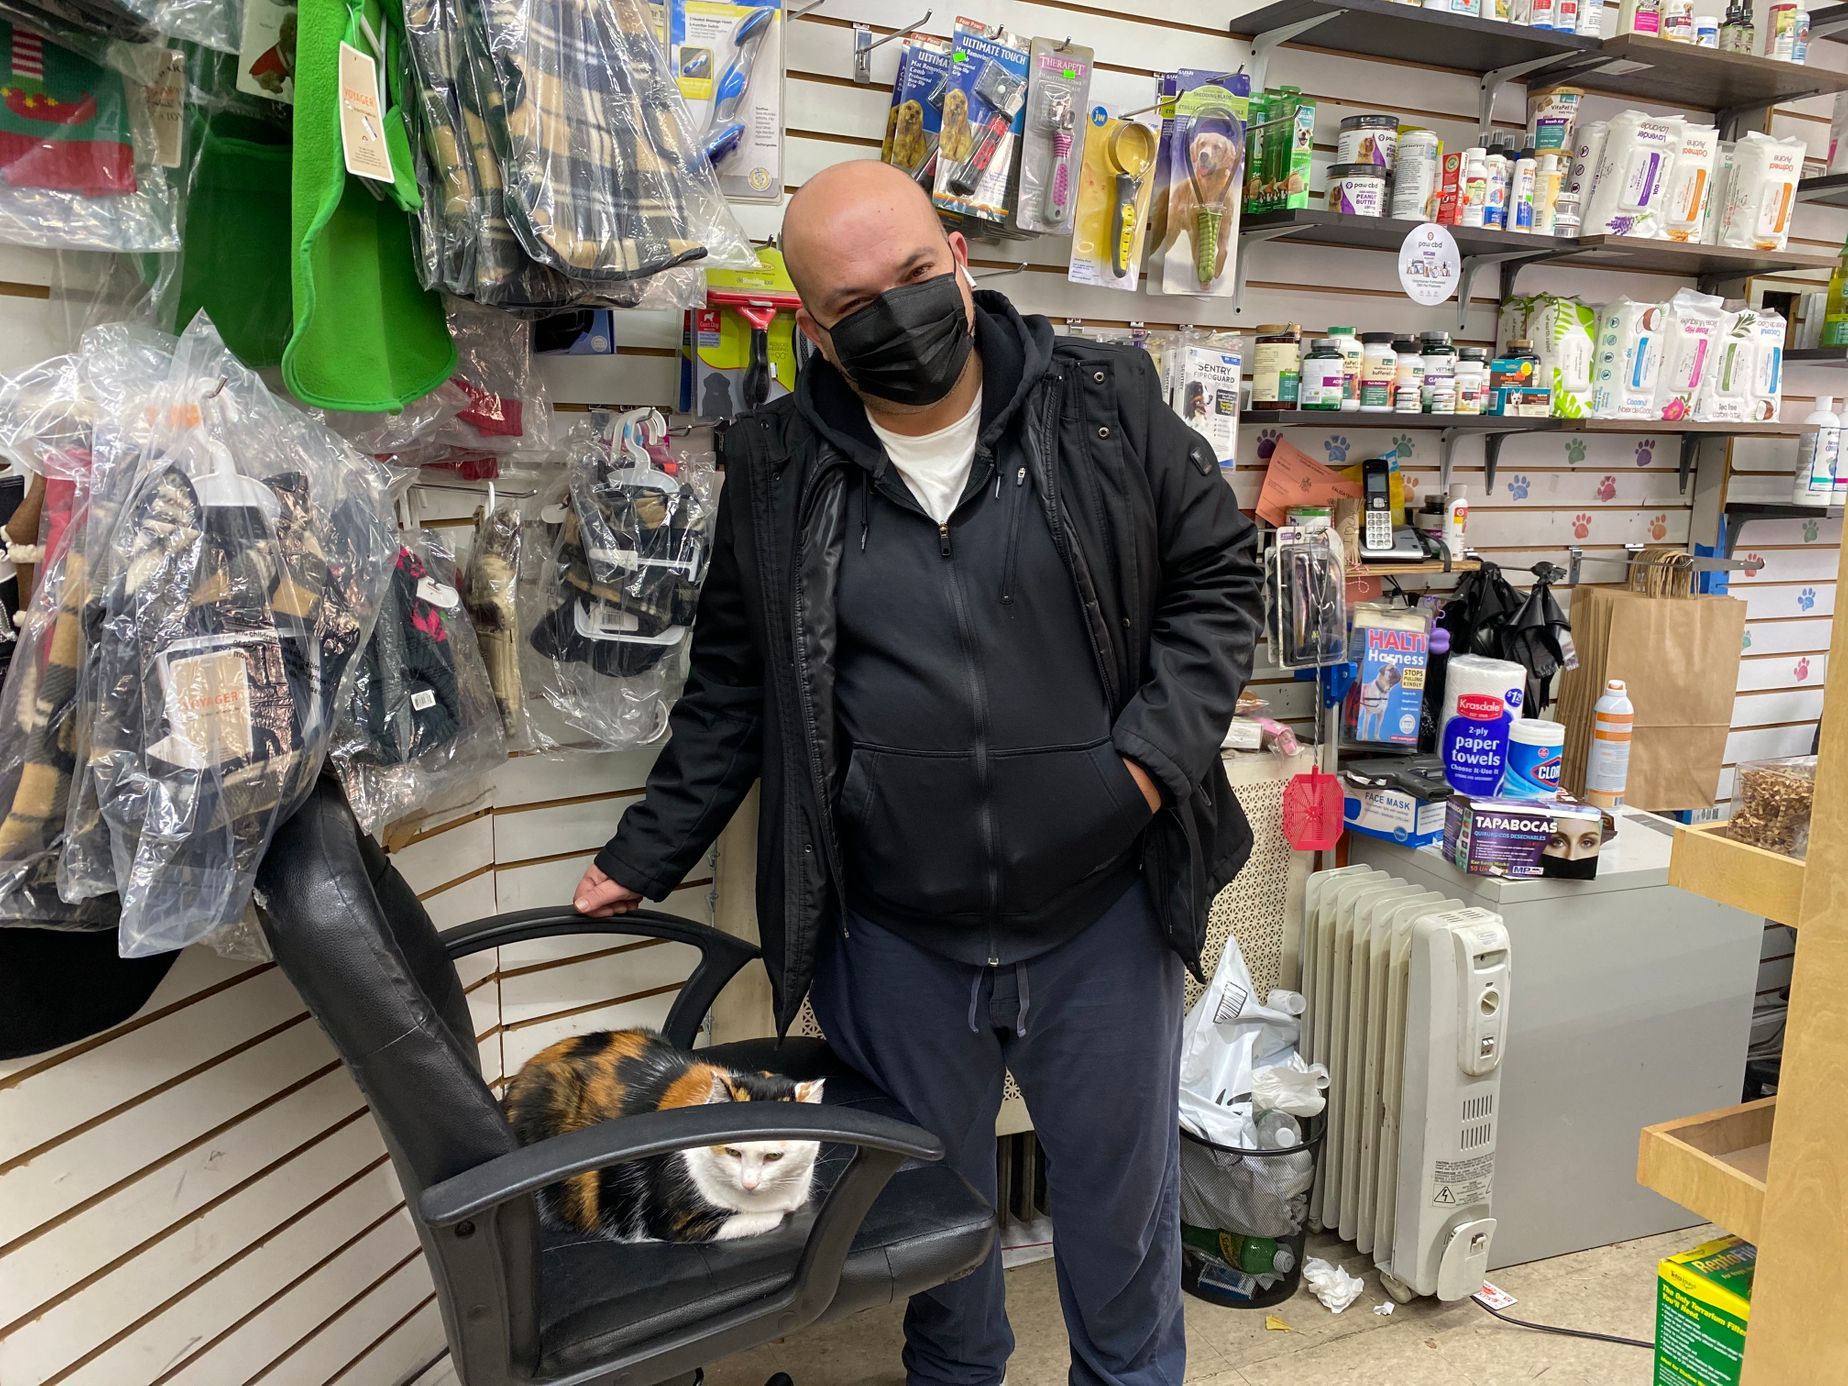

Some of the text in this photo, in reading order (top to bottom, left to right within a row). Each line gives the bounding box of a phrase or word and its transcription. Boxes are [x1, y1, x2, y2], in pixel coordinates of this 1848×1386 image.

[963, 37, 1026, 65] ULTIMATE TOUCH
[1641, 122, 1669, 133] Lavande
[1637, 131, 1666, 143] Lavender
[1760, 328, 1781, 336] Coconut
[1198, 364, 1232, 376] SENTRY
[1194, 371, 1235, 383] FIPROGUARD
[1627, 398, 1647, 406] Coconut
[1719, 403, 1738, 411] Tea Tree
[1368, 629, 1428, 652] HALTI
[1369, 650, 1424, 666] Harness
[1404, 669, 1423, 677] STOPS
[1460, 698, 1500, 711] Krasdale
[1469, 726, 1488, 736] 2-ply
[1455, 736, 1500, 752] paper
[1452, 749, 1501, 766] towels
[1450, 763, 1472, 773] Choose
[1365, 792, 1410, 810] FACE MASK
[1475, 816, 1558, 833] TAPABOCAS
[1510, 833, 1546, 841] DESECHABLES
[1662, 1284, 1674, 1296] The
[1675, 1290, 1691, 1306] Only
[1691, 1301, 1725, 1326] Terrarium
[1662, 1292, 1699, 1321] You'll Need.
